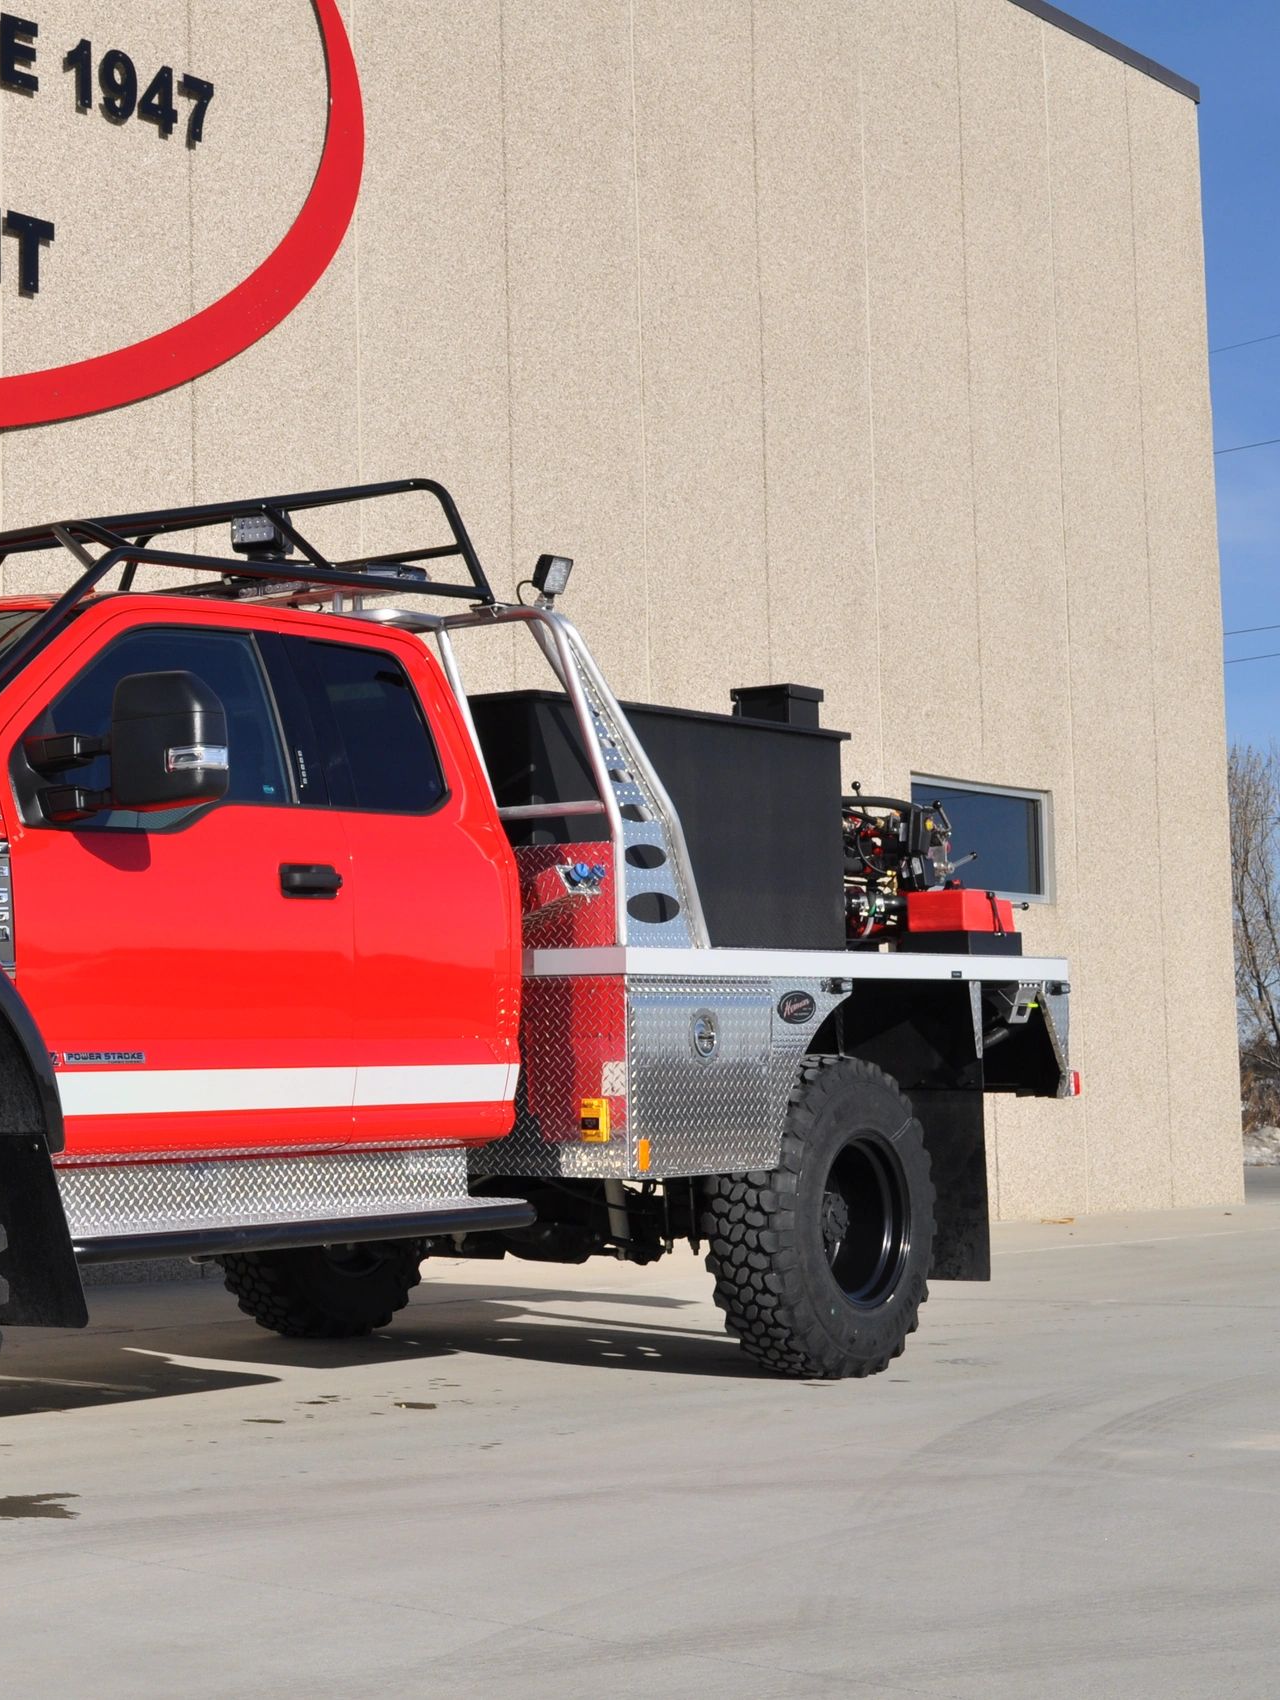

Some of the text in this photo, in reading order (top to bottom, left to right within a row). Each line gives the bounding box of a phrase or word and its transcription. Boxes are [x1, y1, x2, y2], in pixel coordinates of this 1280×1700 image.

[66, 38, 215, 142] 1947
[67, 1052, 102, 1061] POWER
[104, 1052, 144, 1061] STROKE
